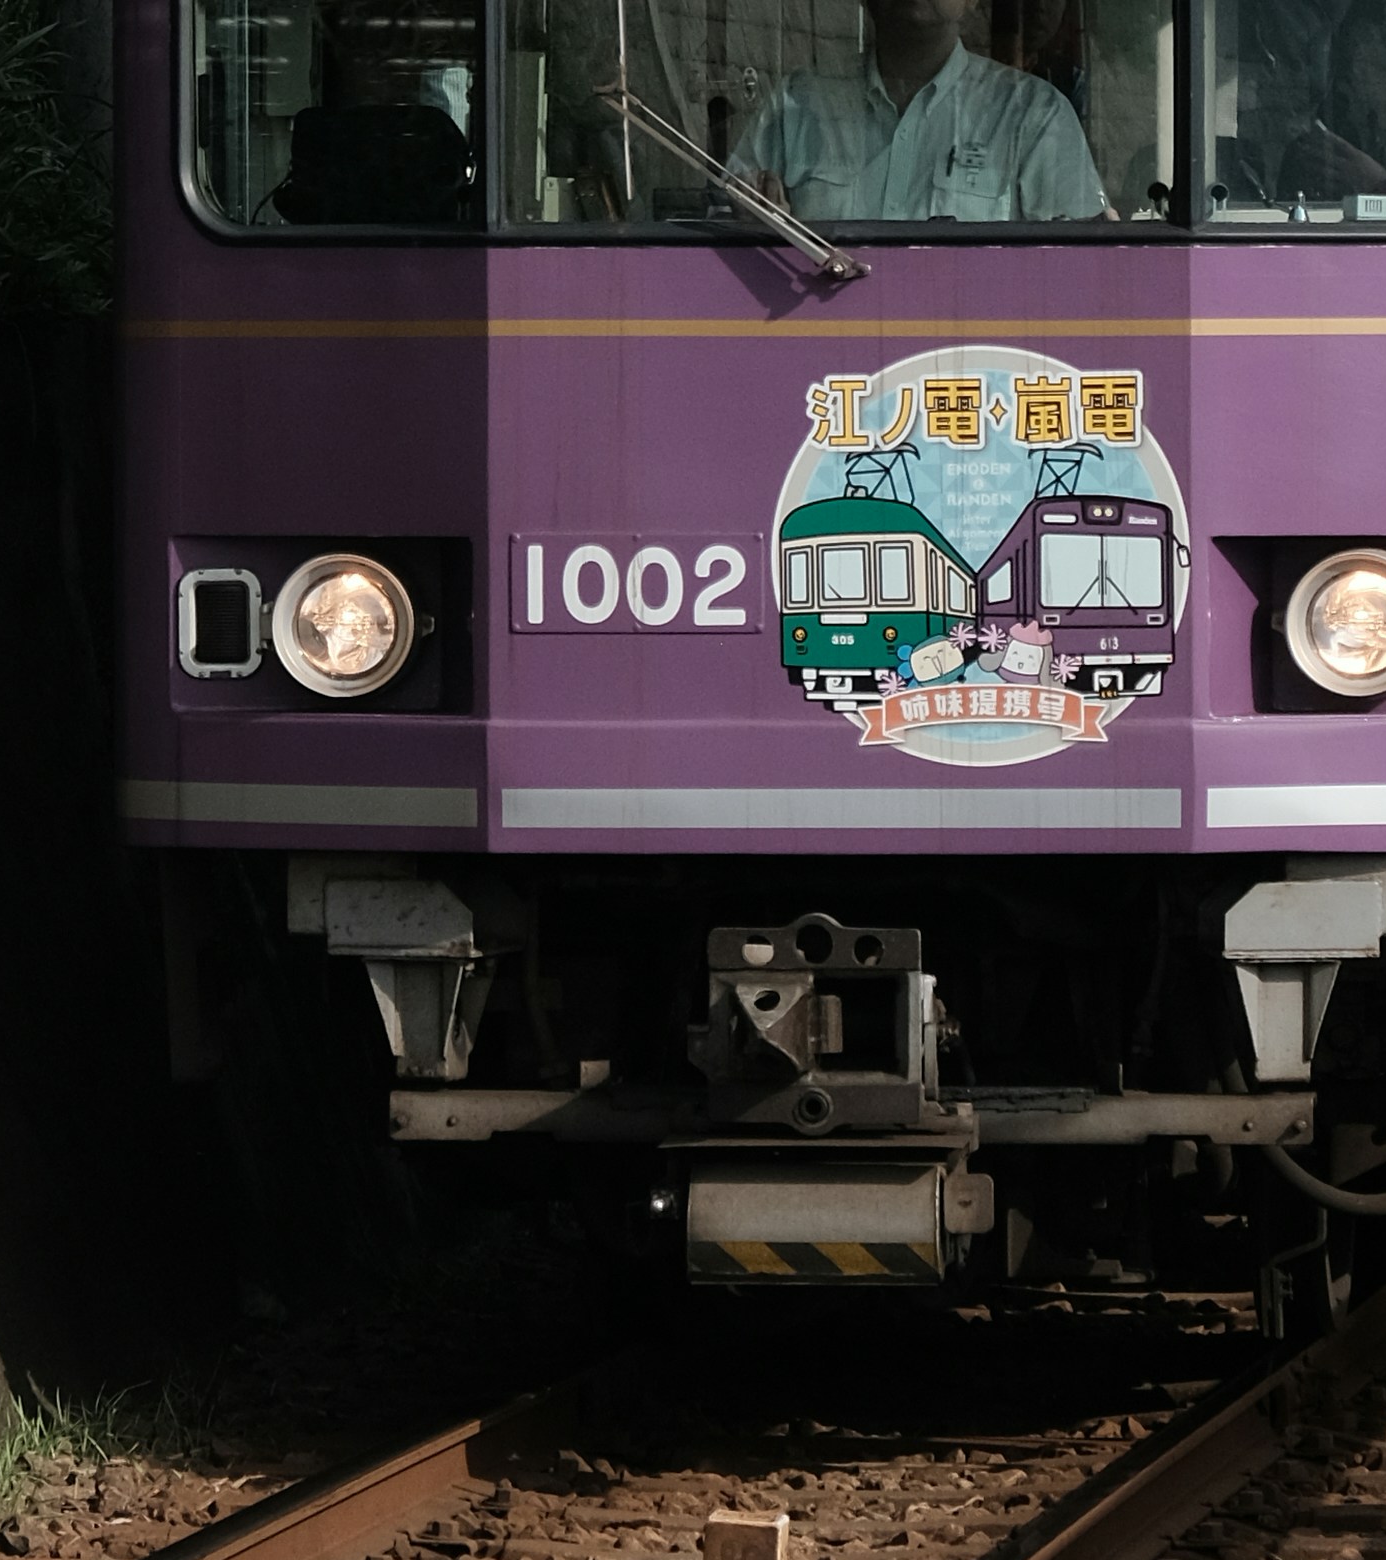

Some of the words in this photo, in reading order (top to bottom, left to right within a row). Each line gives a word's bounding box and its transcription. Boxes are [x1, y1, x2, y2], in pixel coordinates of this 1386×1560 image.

[946, 462, 1012, 476] ENODEN
[946, 492, 1013, 506] RANDEN
[527, 544, 747, 626] 1002
[831, 634, 855, 646] 305
[1099, 636, 1120, 651] 613
[899, 688, 1066, 722] 姉妹提携号
